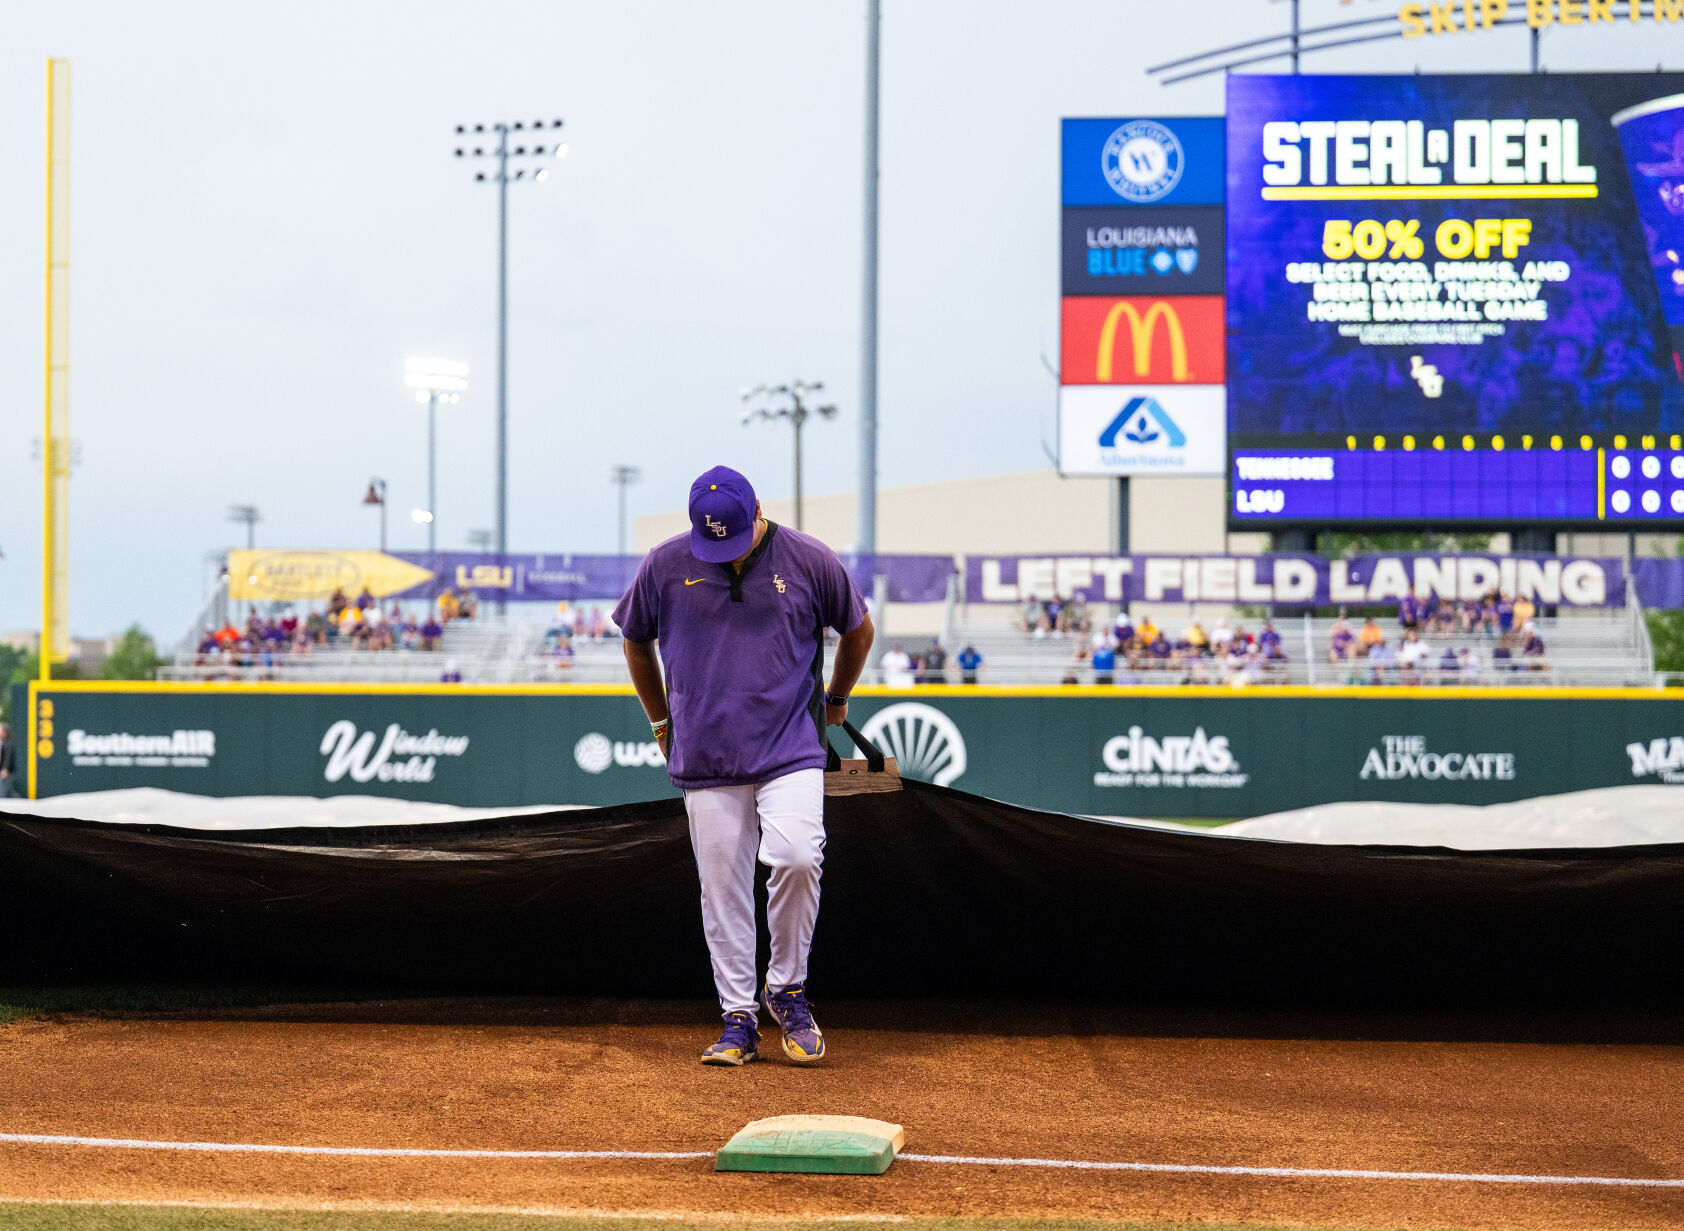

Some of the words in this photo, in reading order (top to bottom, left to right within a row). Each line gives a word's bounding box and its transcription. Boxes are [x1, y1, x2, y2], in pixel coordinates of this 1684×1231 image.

[1398, 0, 1507, 38] SKIP
[1263, 120, 1442, 185] STEAL
[1454, 119, 1597, 184] DEAL
[1086, 226, 1199, 248] LOUISIANA
[1322, 219, 1425, 260] 50%
[1435, 219, 1533, 259] OFF
[1087, 247, 1147, 275] BLUE
[1286, 262, 1366, 283] SELECT
[1367, 262, 1433, 283] FOOD,
[1522, 261, 1571, 282] AND
[1370, 281, 1442, 301] EVERY
[1444, 281, 1542, 301] TUESDAY
[1307, 301, 1372, 322] HOME
[1373, 301, 1483, 321] BASEBALL
[1484, 300, 1548, 321] GAME
[1611, 455, 1631, 479] 0
[1641, 455, 1661, 479] 0
[1236, 489, 1285, 513] LSU
[1611, 489, 1631, 513] 0
[1641, 489, 1661, 513] 0
[705, 514, 727, 537] LSU
[455, 564, 513, 588] LSU
[772, 574, 787, 594] LSU
[981, 558, 1133, 600] LEFT
[1144, 558, 1318, 601] FIELD
[1329, 557, 1606, 604] LANDING
[319, 719, 470, 783] Window
[1381, 735, 1427, 753] THE
[1359, 747, 1517, 780] ADVOCATE
